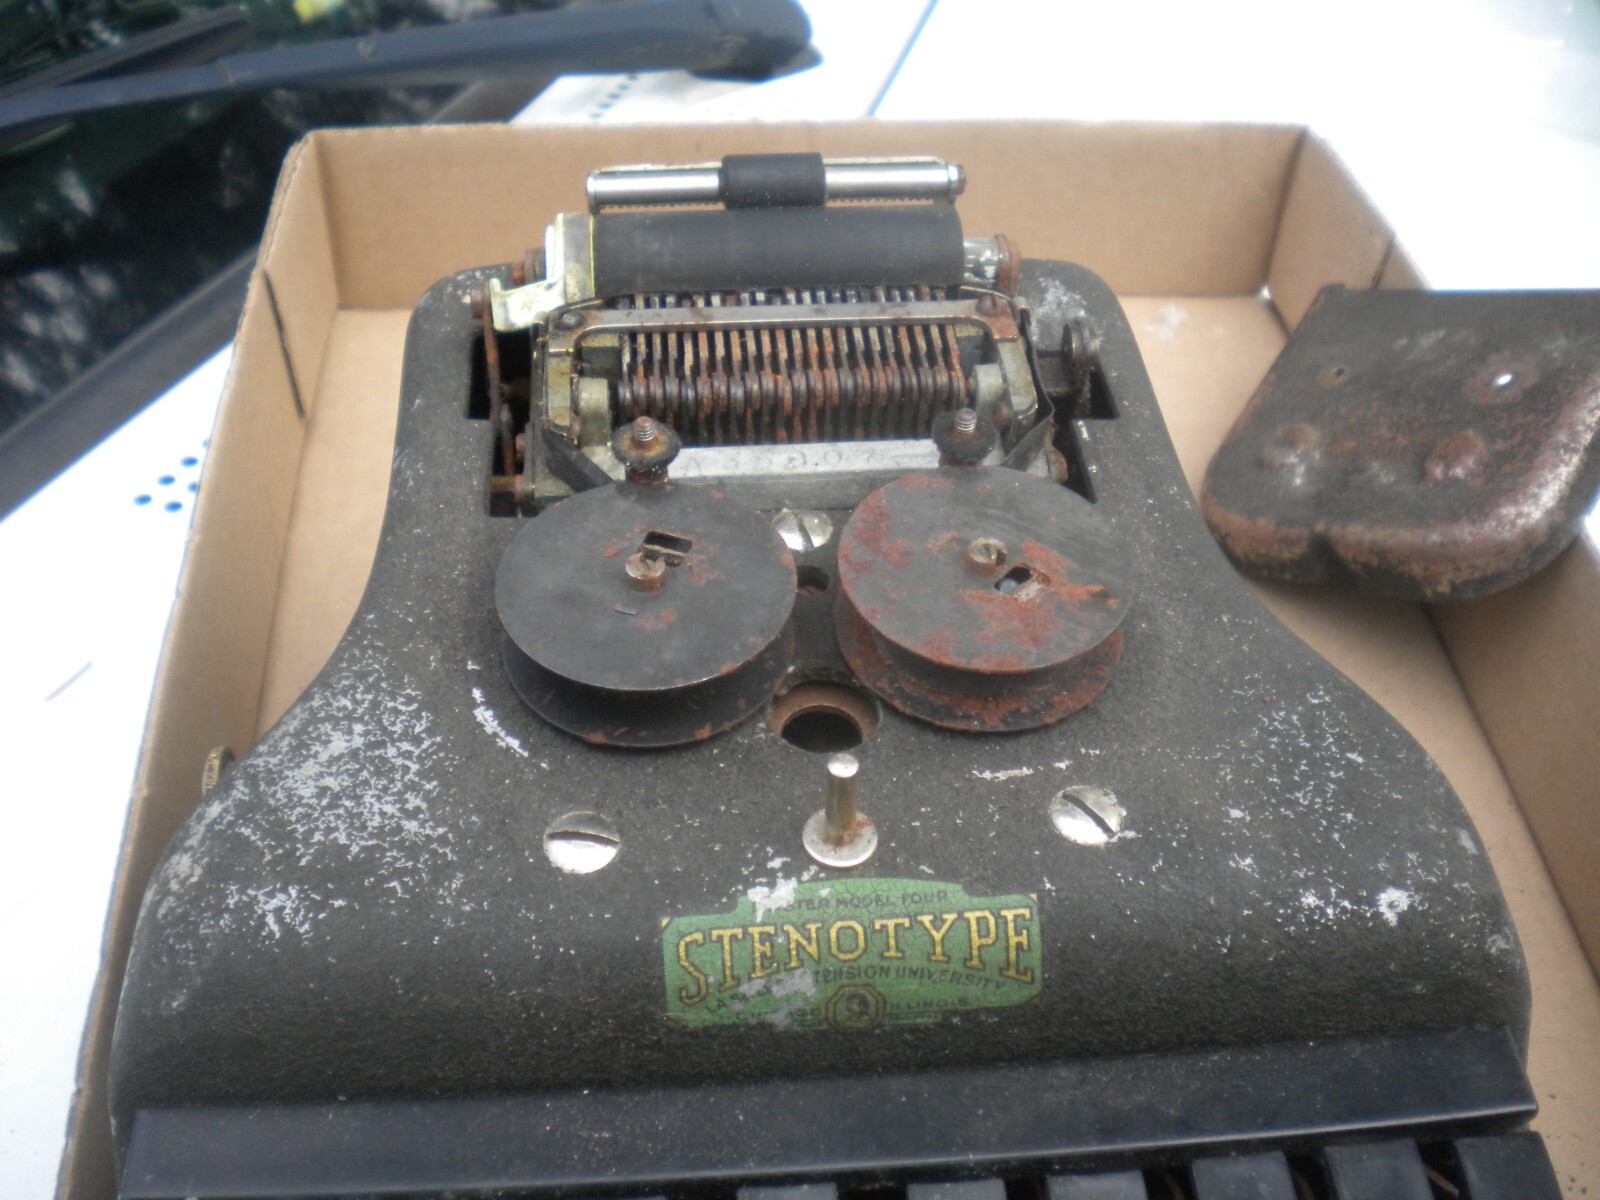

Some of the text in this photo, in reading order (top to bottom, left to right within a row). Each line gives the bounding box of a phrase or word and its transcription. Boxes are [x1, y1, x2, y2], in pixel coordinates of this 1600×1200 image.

[835, 893, 897, 909] MODEL
[901, 889, 948, 906] FOUR
[676, 907, 1034, 1006] STENOTYPE
[895, 965, 1008, 990] UNIVERSITY
